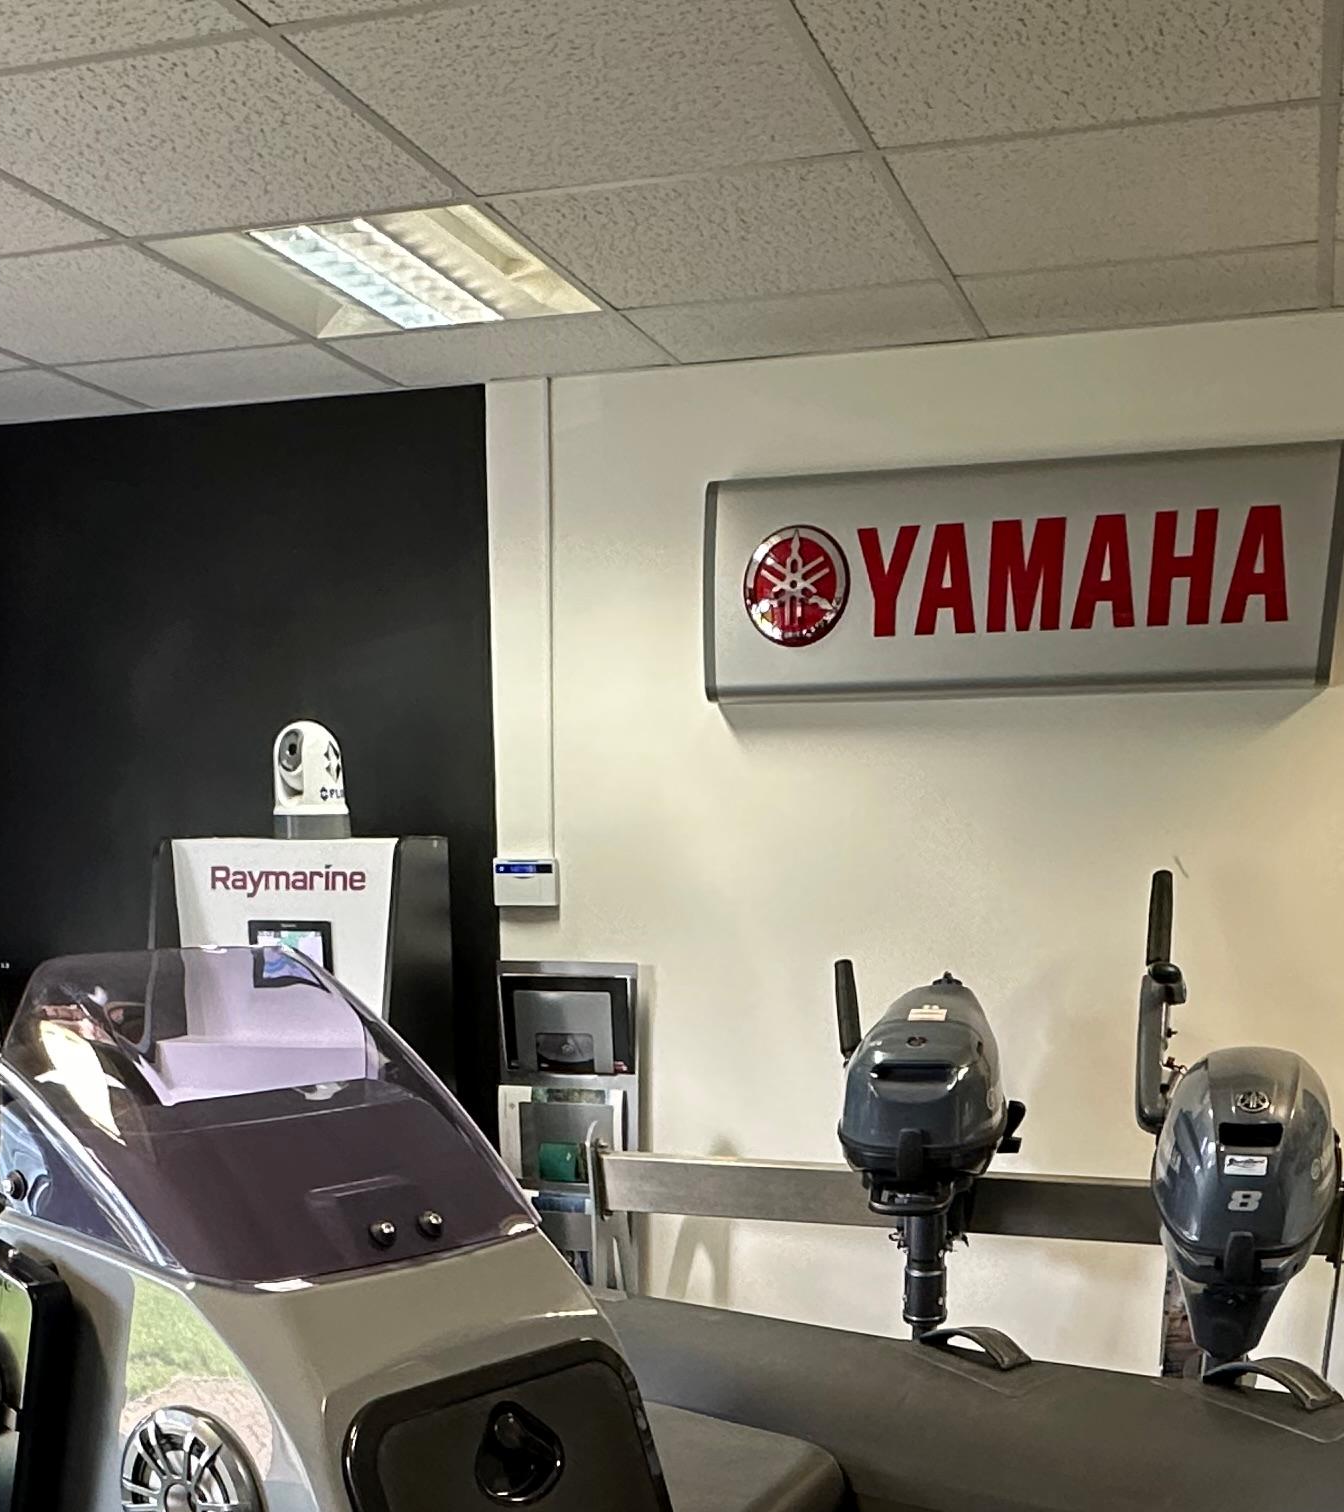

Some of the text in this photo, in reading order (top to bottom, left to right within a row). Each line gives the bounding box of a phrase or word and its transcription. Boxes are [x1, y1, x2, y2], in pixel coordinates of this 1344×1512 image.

[857, 504, 1290, 637] YAMAHA
[210, 864, 366, 898] Raymarine
[1228, 1190, 1262, 1211] 8
